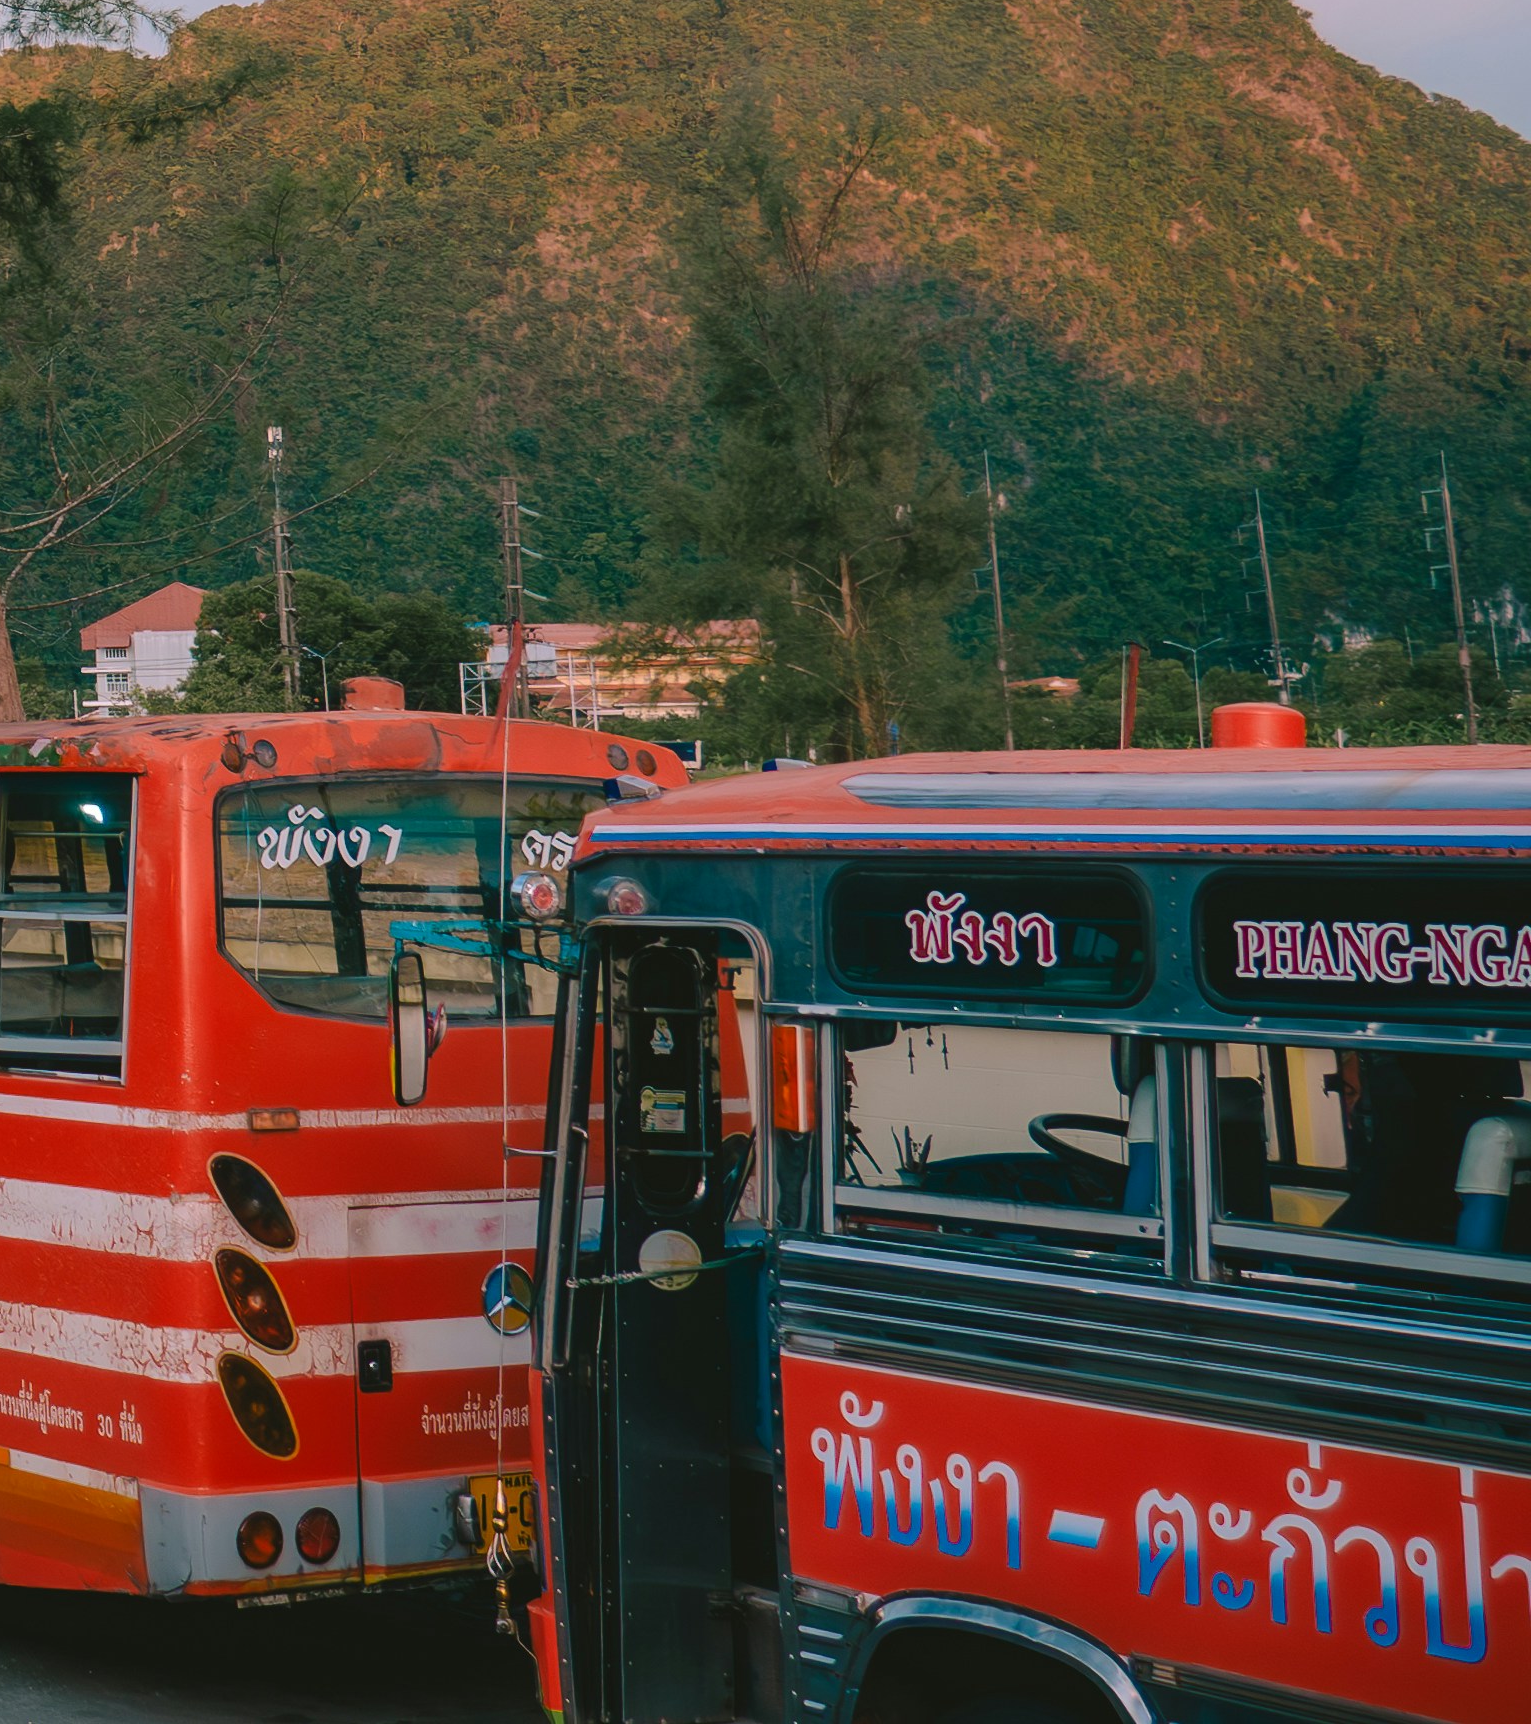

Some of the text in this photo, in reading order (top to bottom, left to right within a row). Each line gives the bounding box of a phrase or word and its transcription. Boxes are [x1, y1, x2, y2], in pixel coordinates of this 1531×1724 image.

[257, 804, 402, 870] พังงา
[905, 890, 1057, 967] พังงา
[1233, 921, 1531, 987] PHANG-NGA
[97, 1413, 113, 1439] 30
[119, 1400, 143, 1445] ที่นั่ง
[811, 1390, 1021, 1570] พังงา
